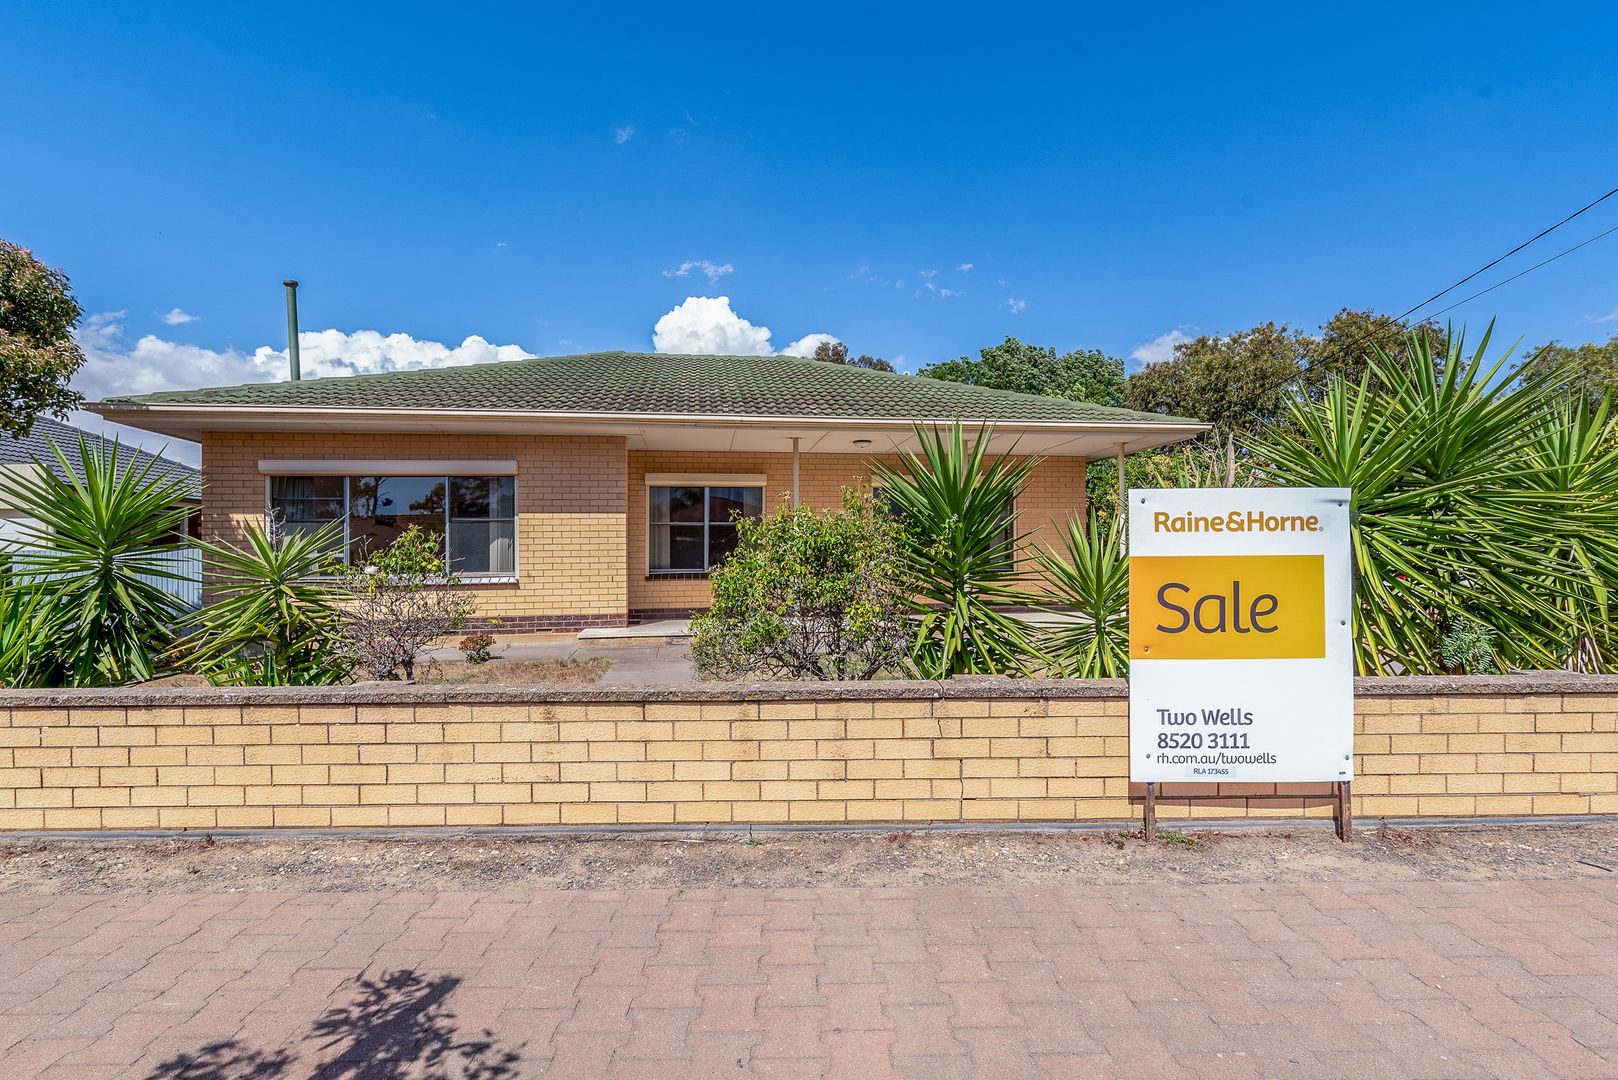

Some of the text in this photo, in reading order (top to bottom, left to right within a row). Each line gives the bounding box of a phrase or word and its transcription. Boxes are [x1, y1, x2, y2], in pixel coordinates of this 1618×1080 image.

[1154, 511, 1319, 533] Raine&Horne
[1156, 580, 1279, 634] Sale
[1156, 708, 1253, 726] Two Wells
[1157, 732, 1250, 749] 8520 3111
[1156, 752, 1277, 766] rh.com.au/twowells
